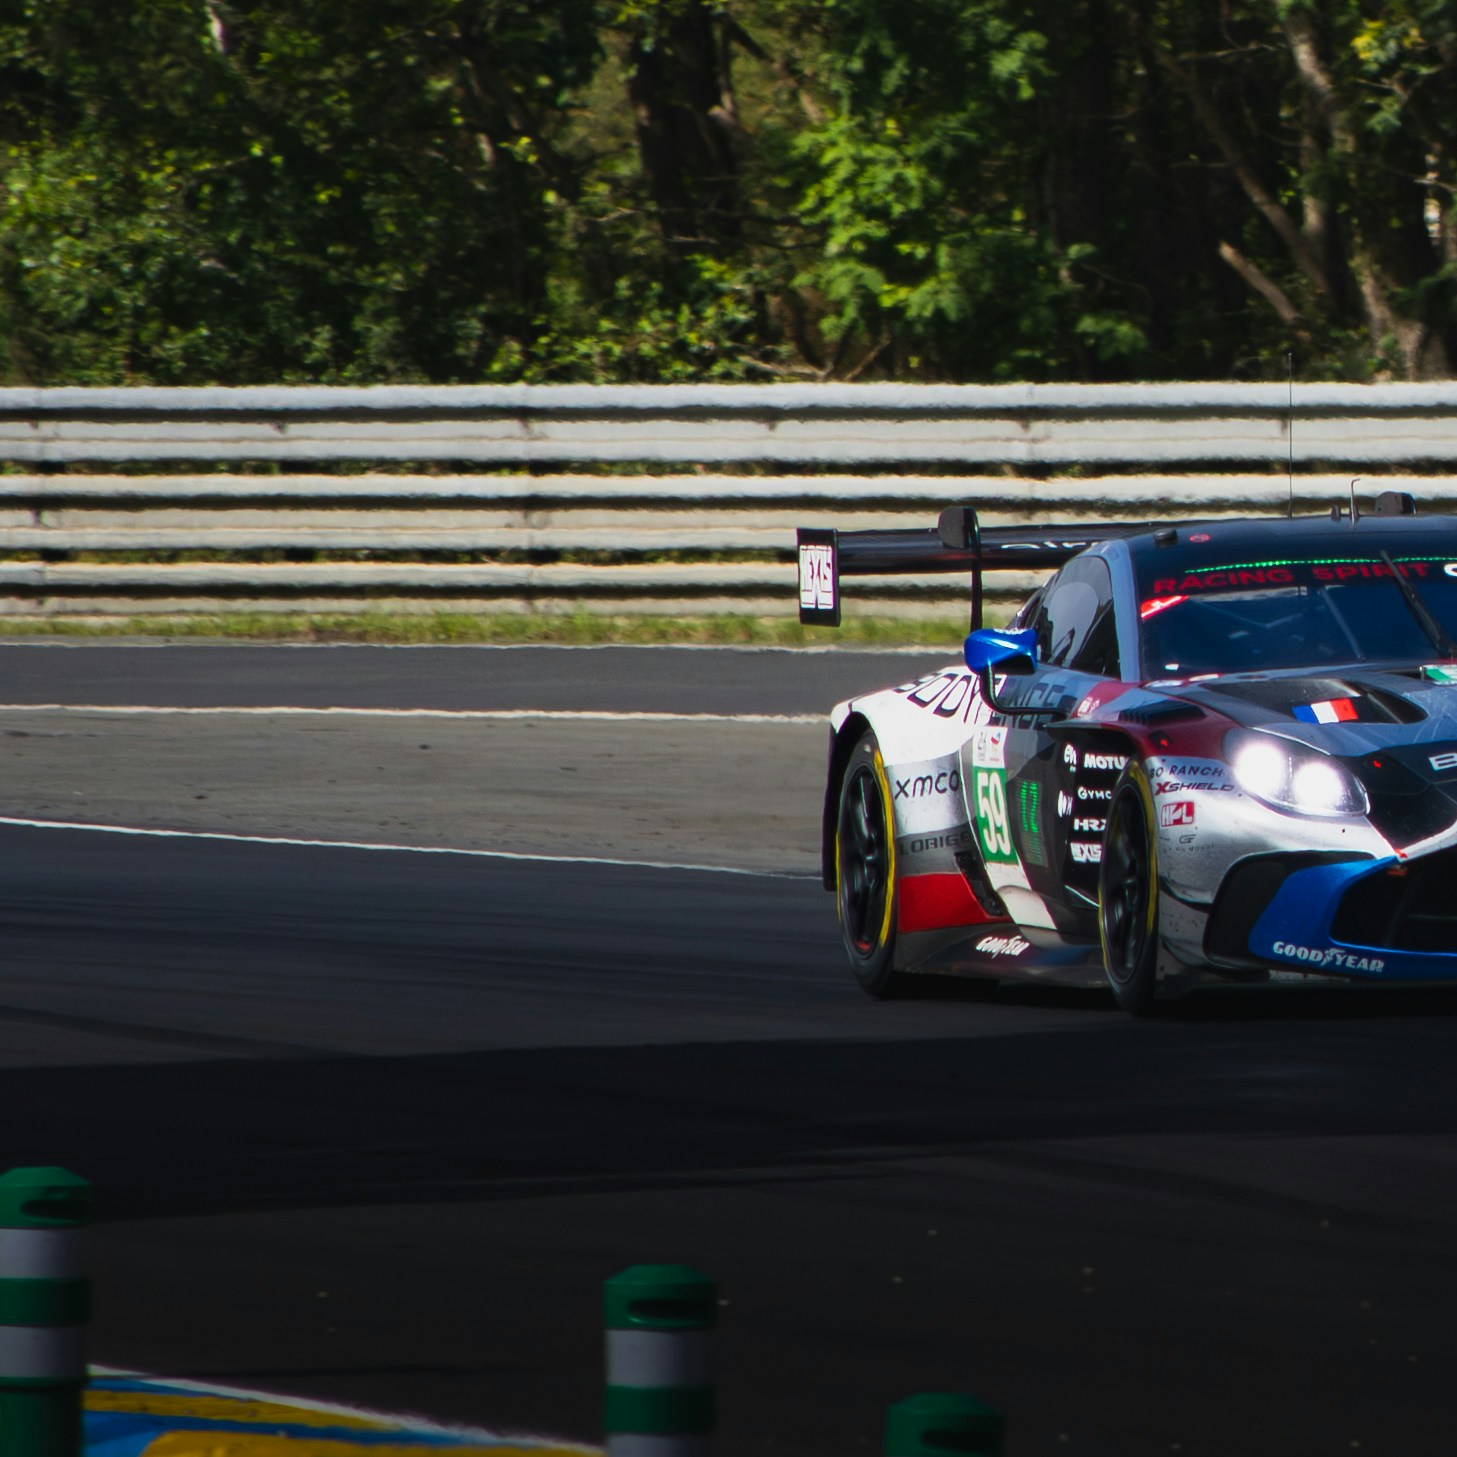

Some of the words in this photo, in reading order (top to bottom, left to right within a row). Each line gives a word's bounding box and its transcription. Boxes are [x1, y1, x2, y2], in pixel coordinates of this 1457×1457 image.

[1153, 569, 1294, 594] RACING
[1312, 562, 1430, 580] SPIRIT
[1169, 765, 1224, 776] RANCH
[977, 771, 1011, 856] 59
